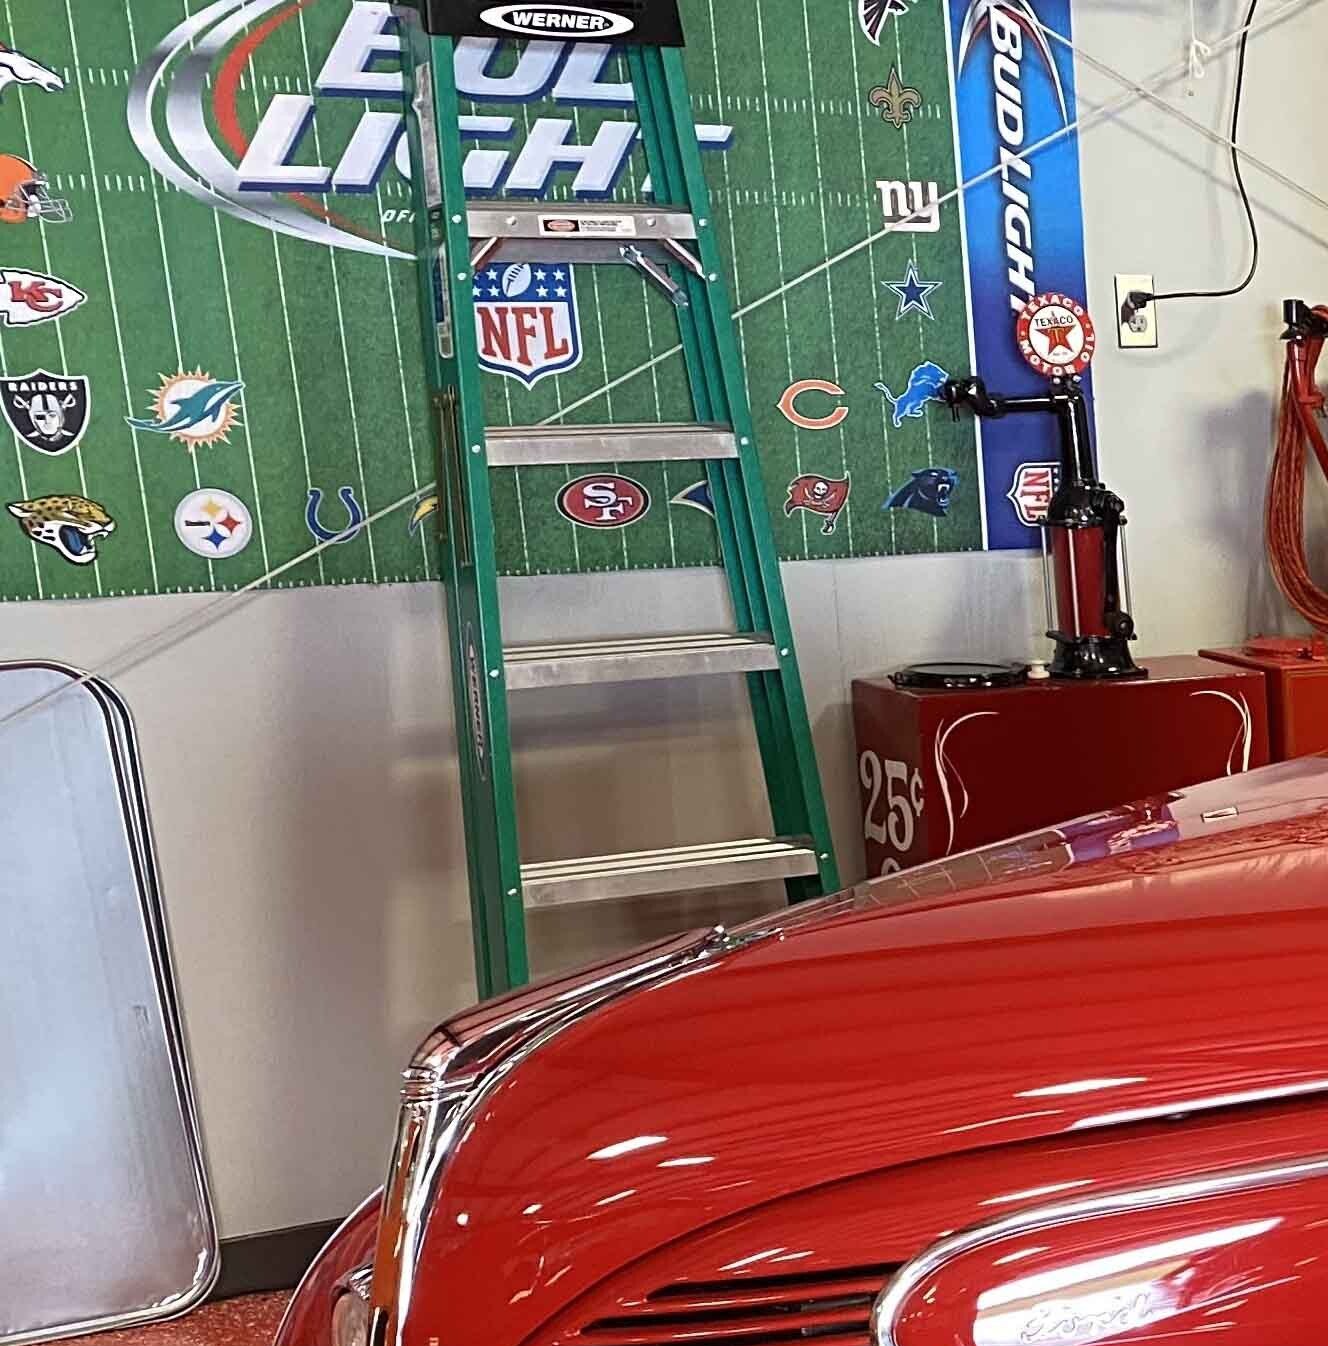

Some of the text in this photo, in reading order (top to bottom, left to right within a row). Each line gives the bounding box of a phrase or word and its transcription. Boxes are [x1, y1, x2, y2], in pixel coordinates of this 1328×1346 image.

[512, 11, 606, 30] WERNER
[988, 7, 1024, 147] BUD
[1020, 294, 1084, 320] TEXACO
[1034, 315, 1074, 328] TEXACO
[481, 306, 568, 367] NFL
[1019, 333, 1096, 376] MOTOR OIL
[8, 382, 78, 392] RAIDERS
[1020, 470, 1050, 519] NFL
